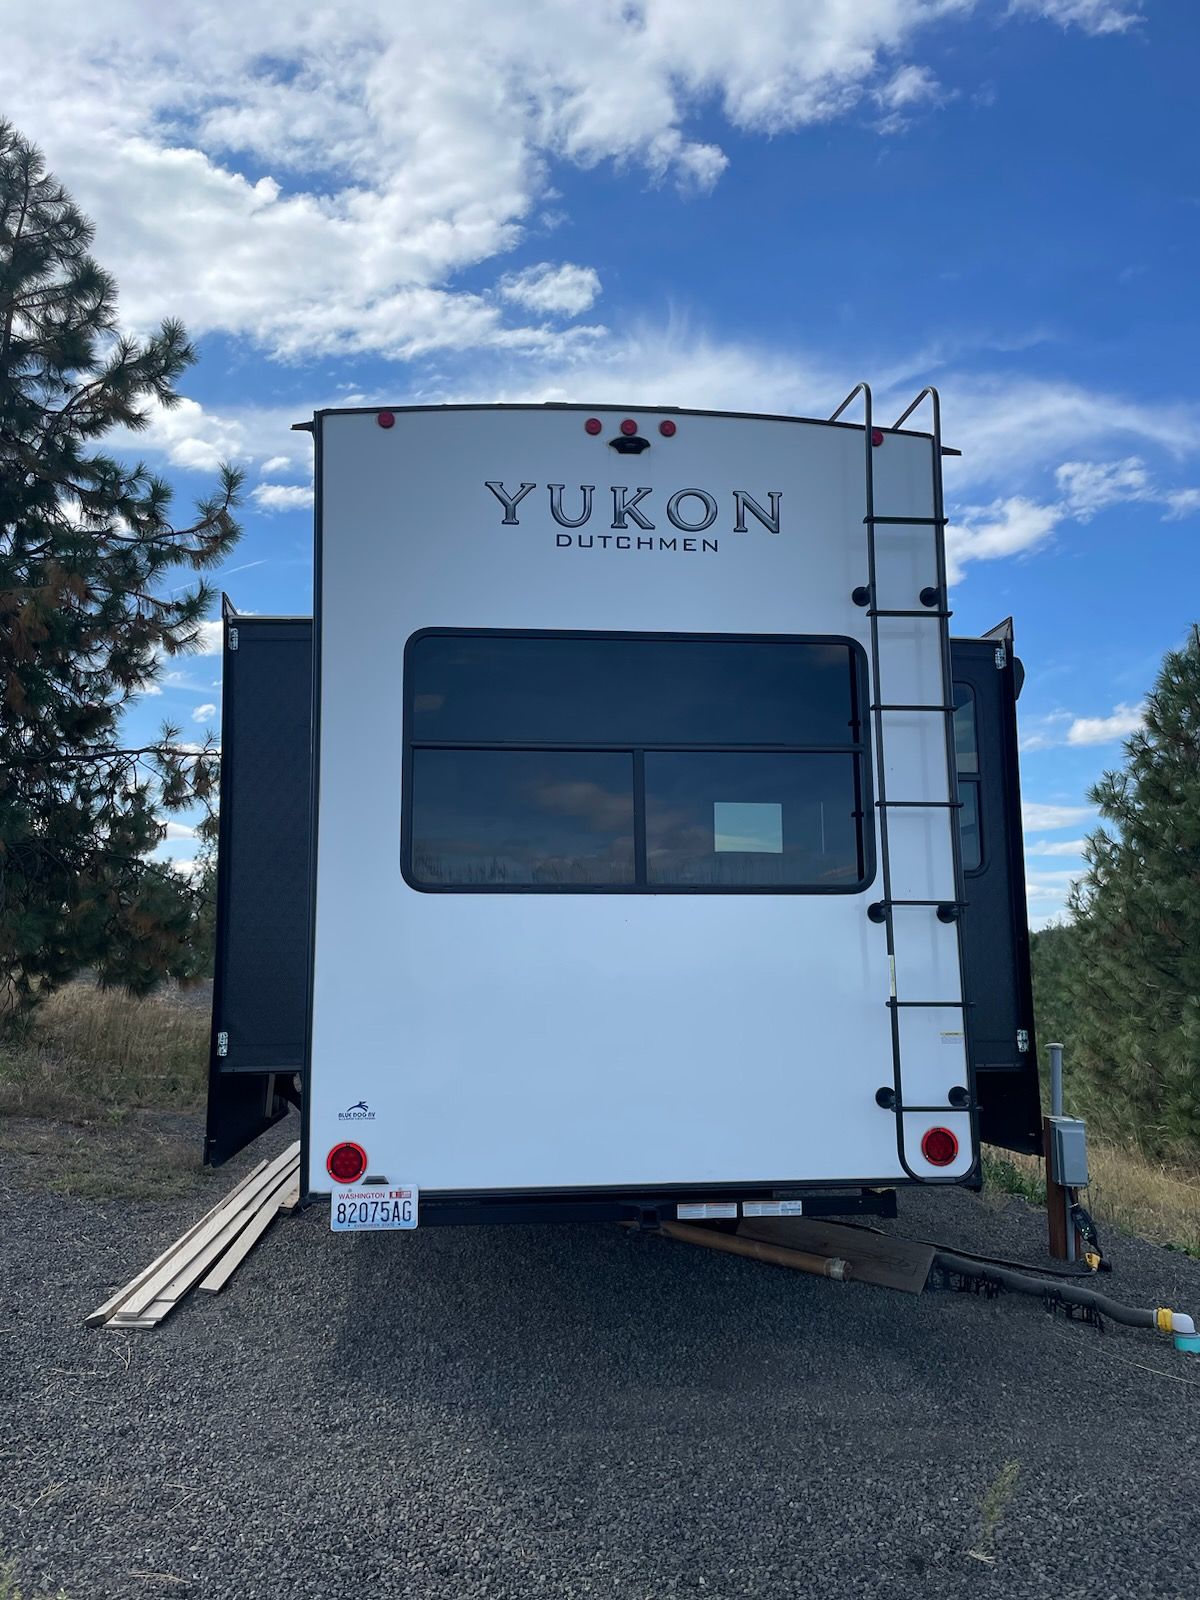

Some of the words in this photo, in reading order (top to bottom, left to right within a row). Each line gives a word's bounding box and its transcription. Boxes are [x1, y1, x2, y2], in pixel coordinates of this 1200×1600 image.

[485, 481, 783, 534] YUKON
[556, 534, 718, 552] DUTCHMEN
[338, 1192, 385, 1200] WASHINGTON
[337, 1200, 412, 1223] 82075AG
